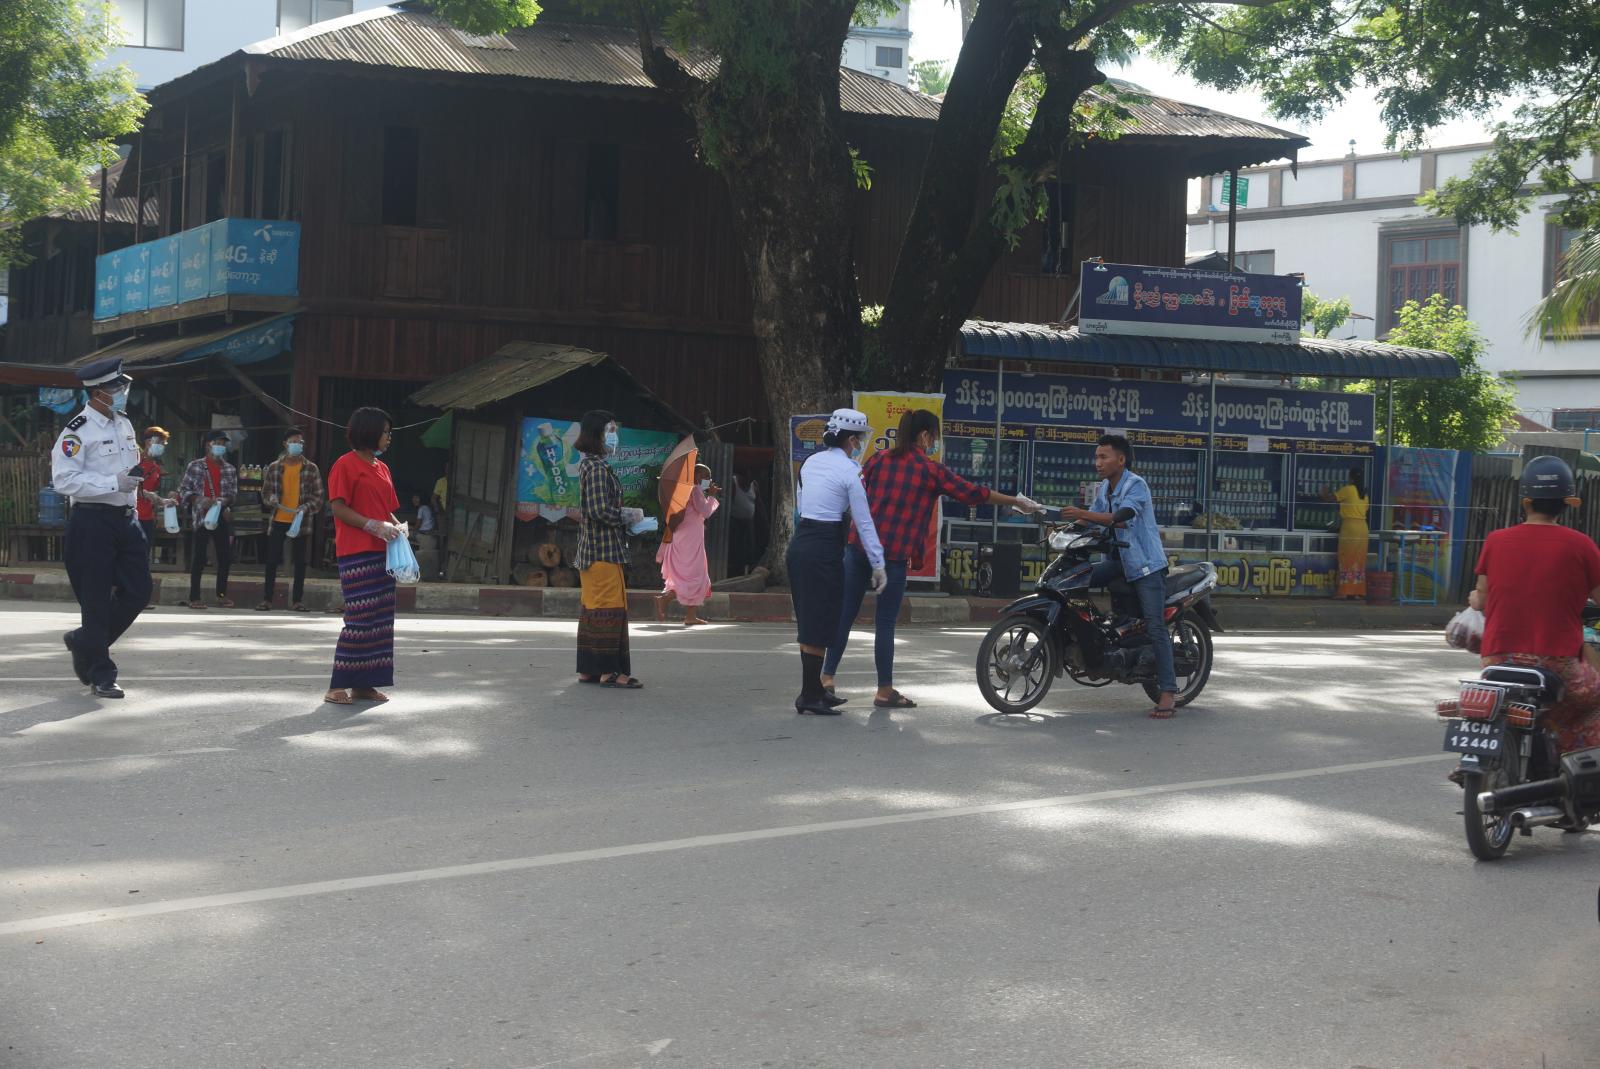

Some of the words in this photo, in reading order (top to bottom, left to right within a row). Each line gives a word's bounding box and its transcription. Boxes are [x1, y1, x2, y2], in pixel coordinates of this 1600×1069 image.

[224, 245, 248, 263] 4G
[546, 447, 567, 495] HYDRO
[1459, 720, 1492, 735] KCN
[1450, 735, 1499, 751] 12440
